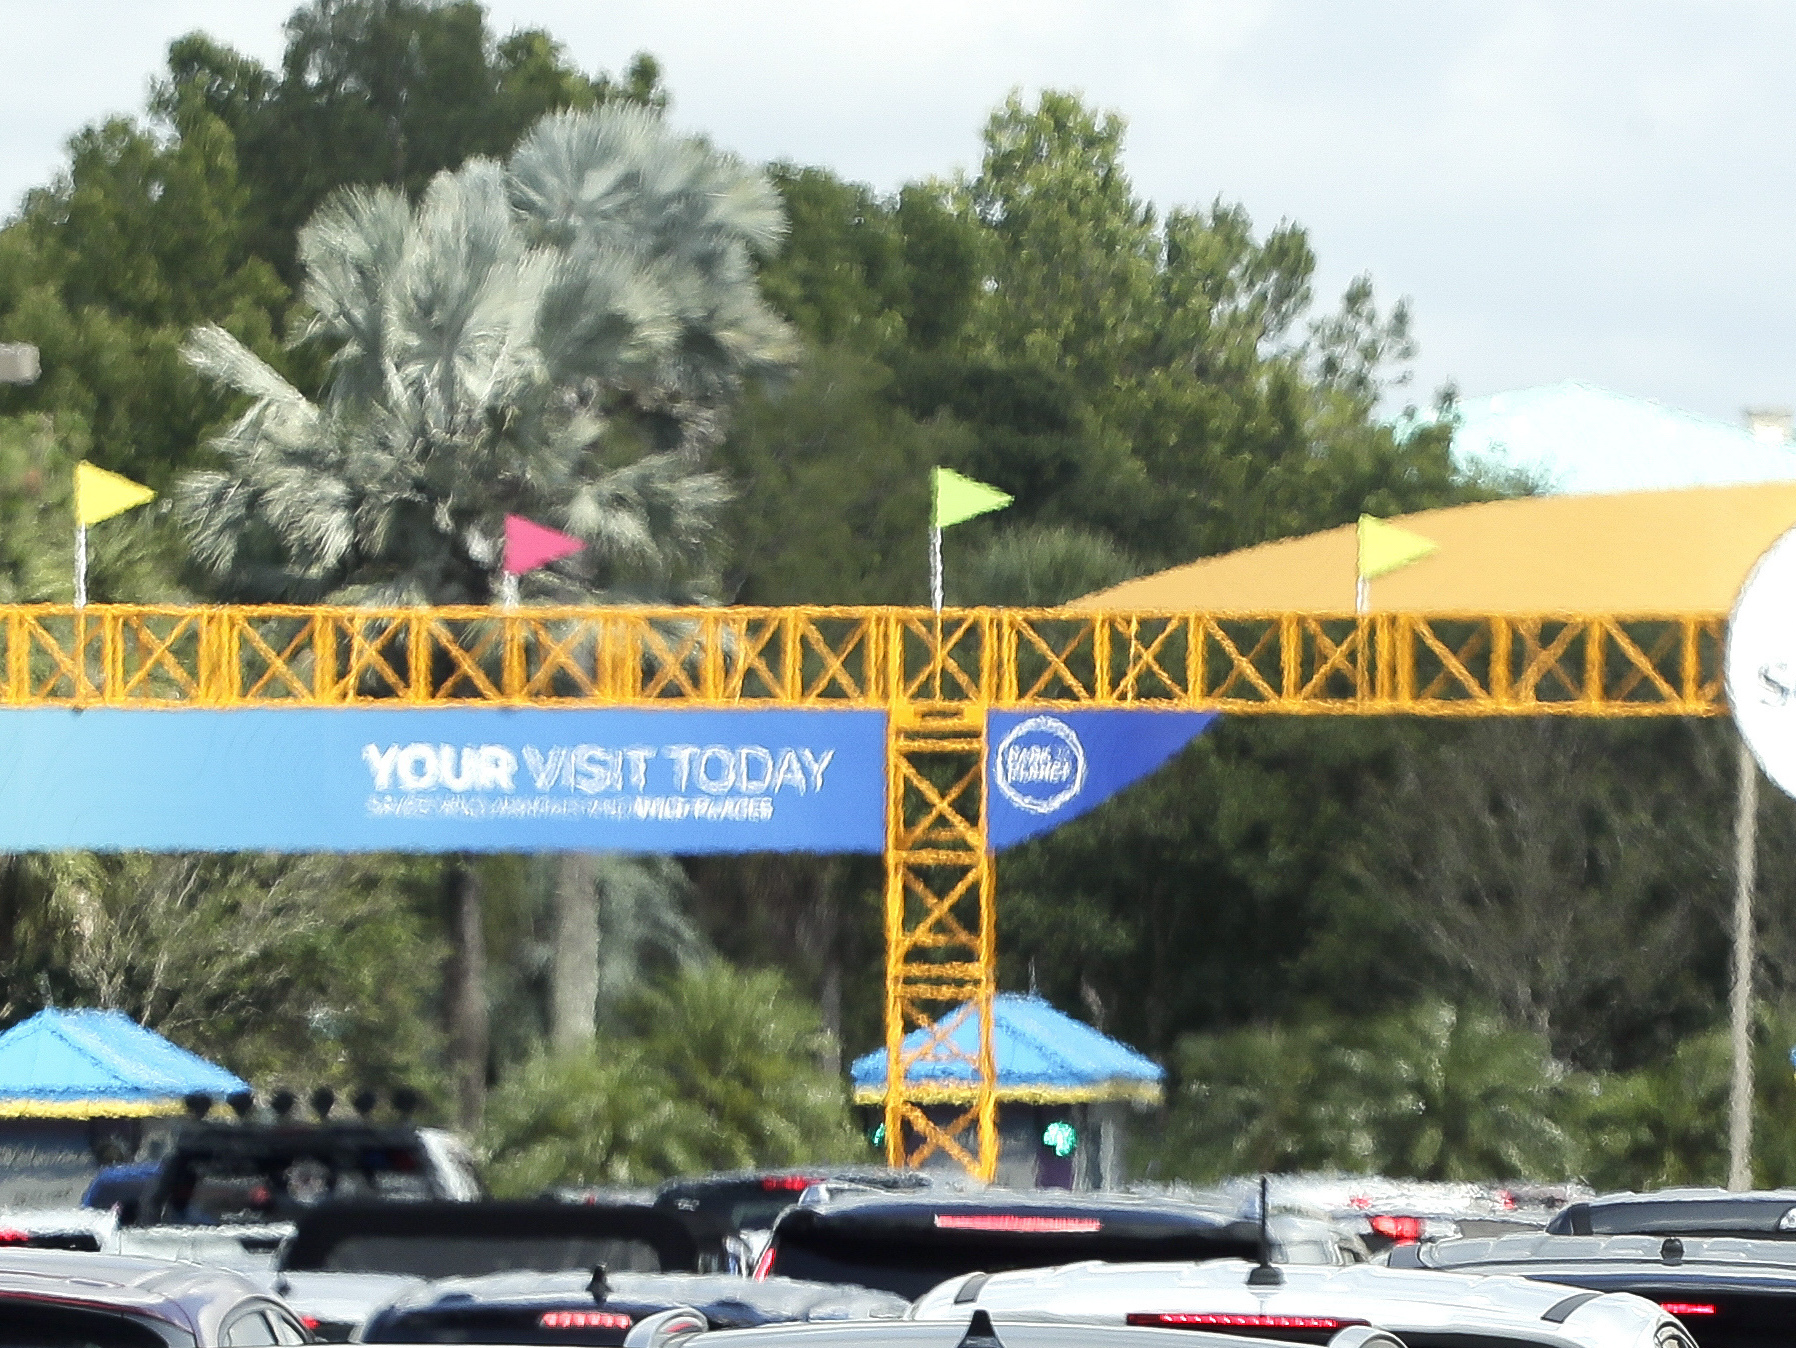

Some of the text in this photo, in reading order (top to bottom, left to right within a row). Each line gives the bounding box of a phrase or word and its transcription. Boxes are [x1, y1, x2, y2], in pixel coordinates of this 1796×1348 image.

[362, 742, 836, 796] YOUR VISIT TODAY
